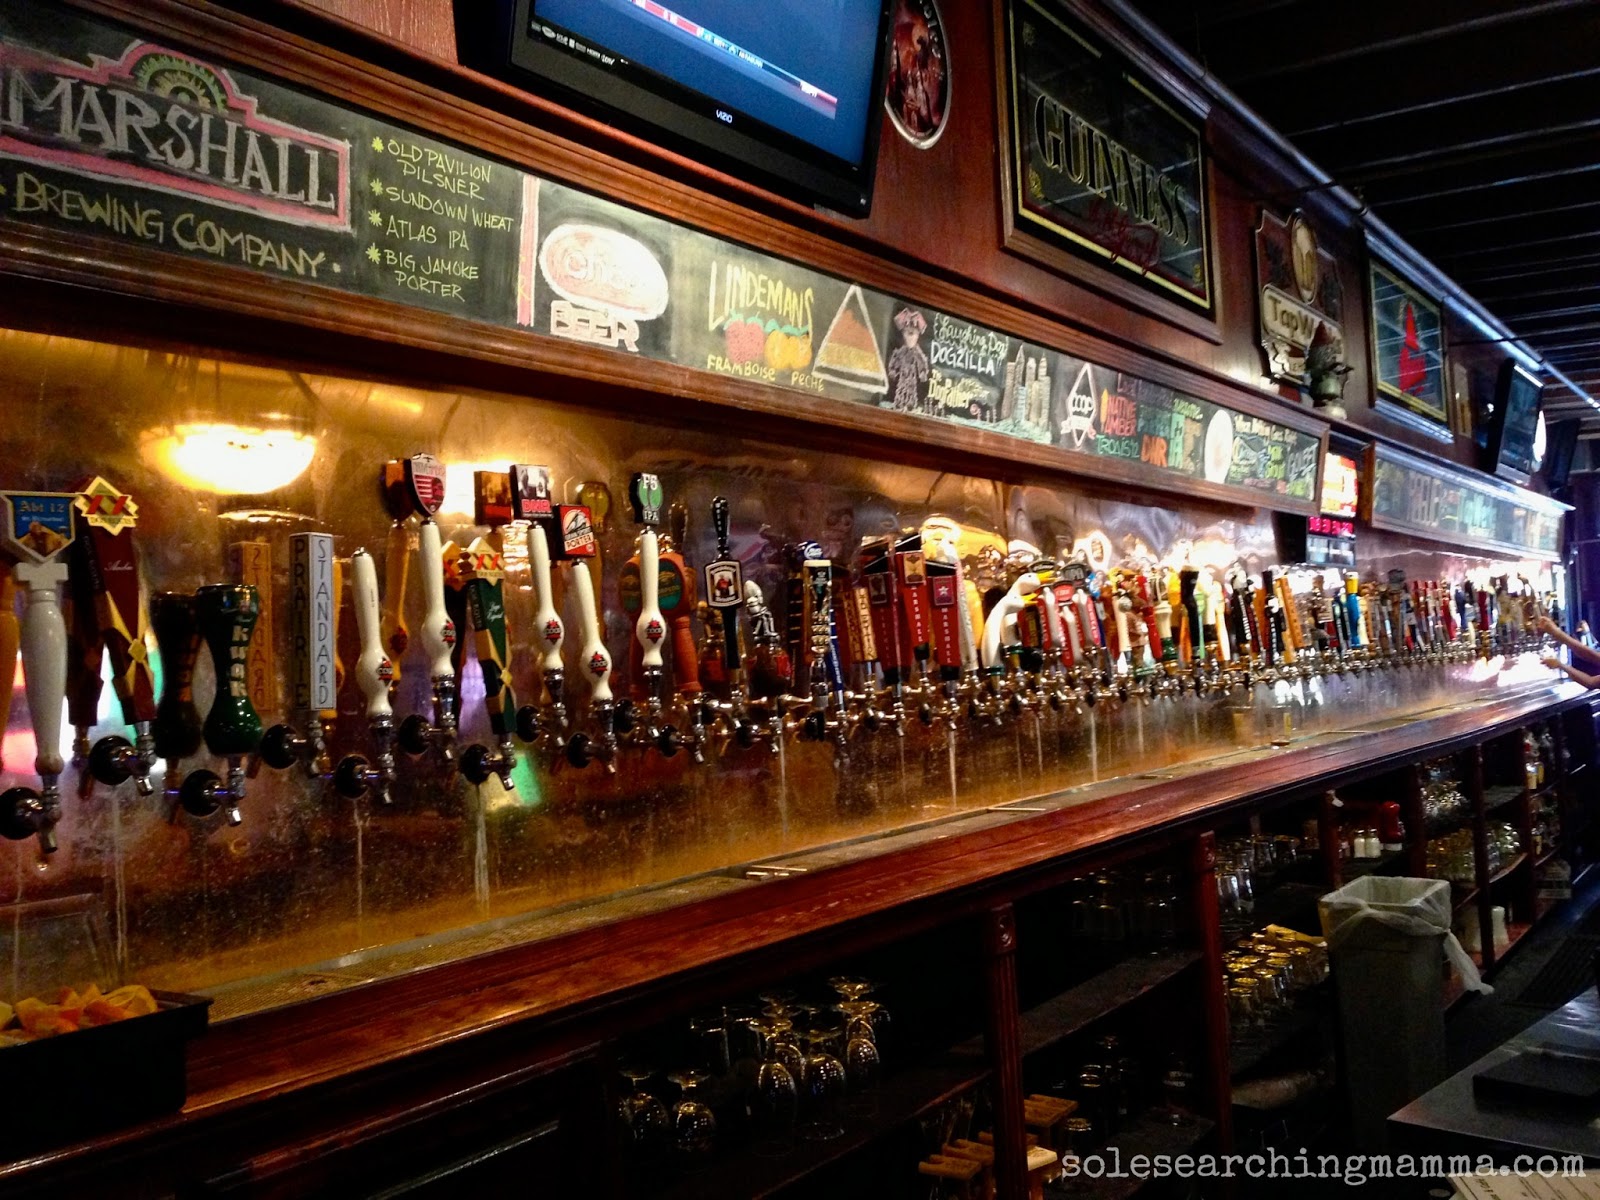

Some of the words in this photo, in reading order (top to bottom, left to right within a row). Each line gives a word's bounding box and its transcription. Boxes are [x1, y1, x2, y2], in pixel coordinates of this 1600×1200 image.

[716, 109, 733, 123] VIZIO
[0, 66, 336, 210] MARSHALL
[388, 139, 423, 162] OLD
[424, 148, 492, 183] PAVILION
[397, 159, 485, 200] PILSNER
[1034, 93, 1190, 247] GUINNESS
[12, 171, 164, 244] BREWING
[172, 213, 326, 278] COMPANY
[386, 186, 467, 222] SUNDOWN
[472, 208, 514, 232] WHEAT
[386, 215, 437, 243] ATLAS
[449, 230, 469, 251] IPA
[384, 249, 415, 272] BIG
[421, 256, 479, 279] JAMOKE
[394, 270, 466, 303] PORTER
[708, 260, 814, 345] LINDEMANS
[930, 340, 996, 377] DOGZILLA
[644, 510, 659, 521] IPA
[315, 538, 331, 705] STANDARD
